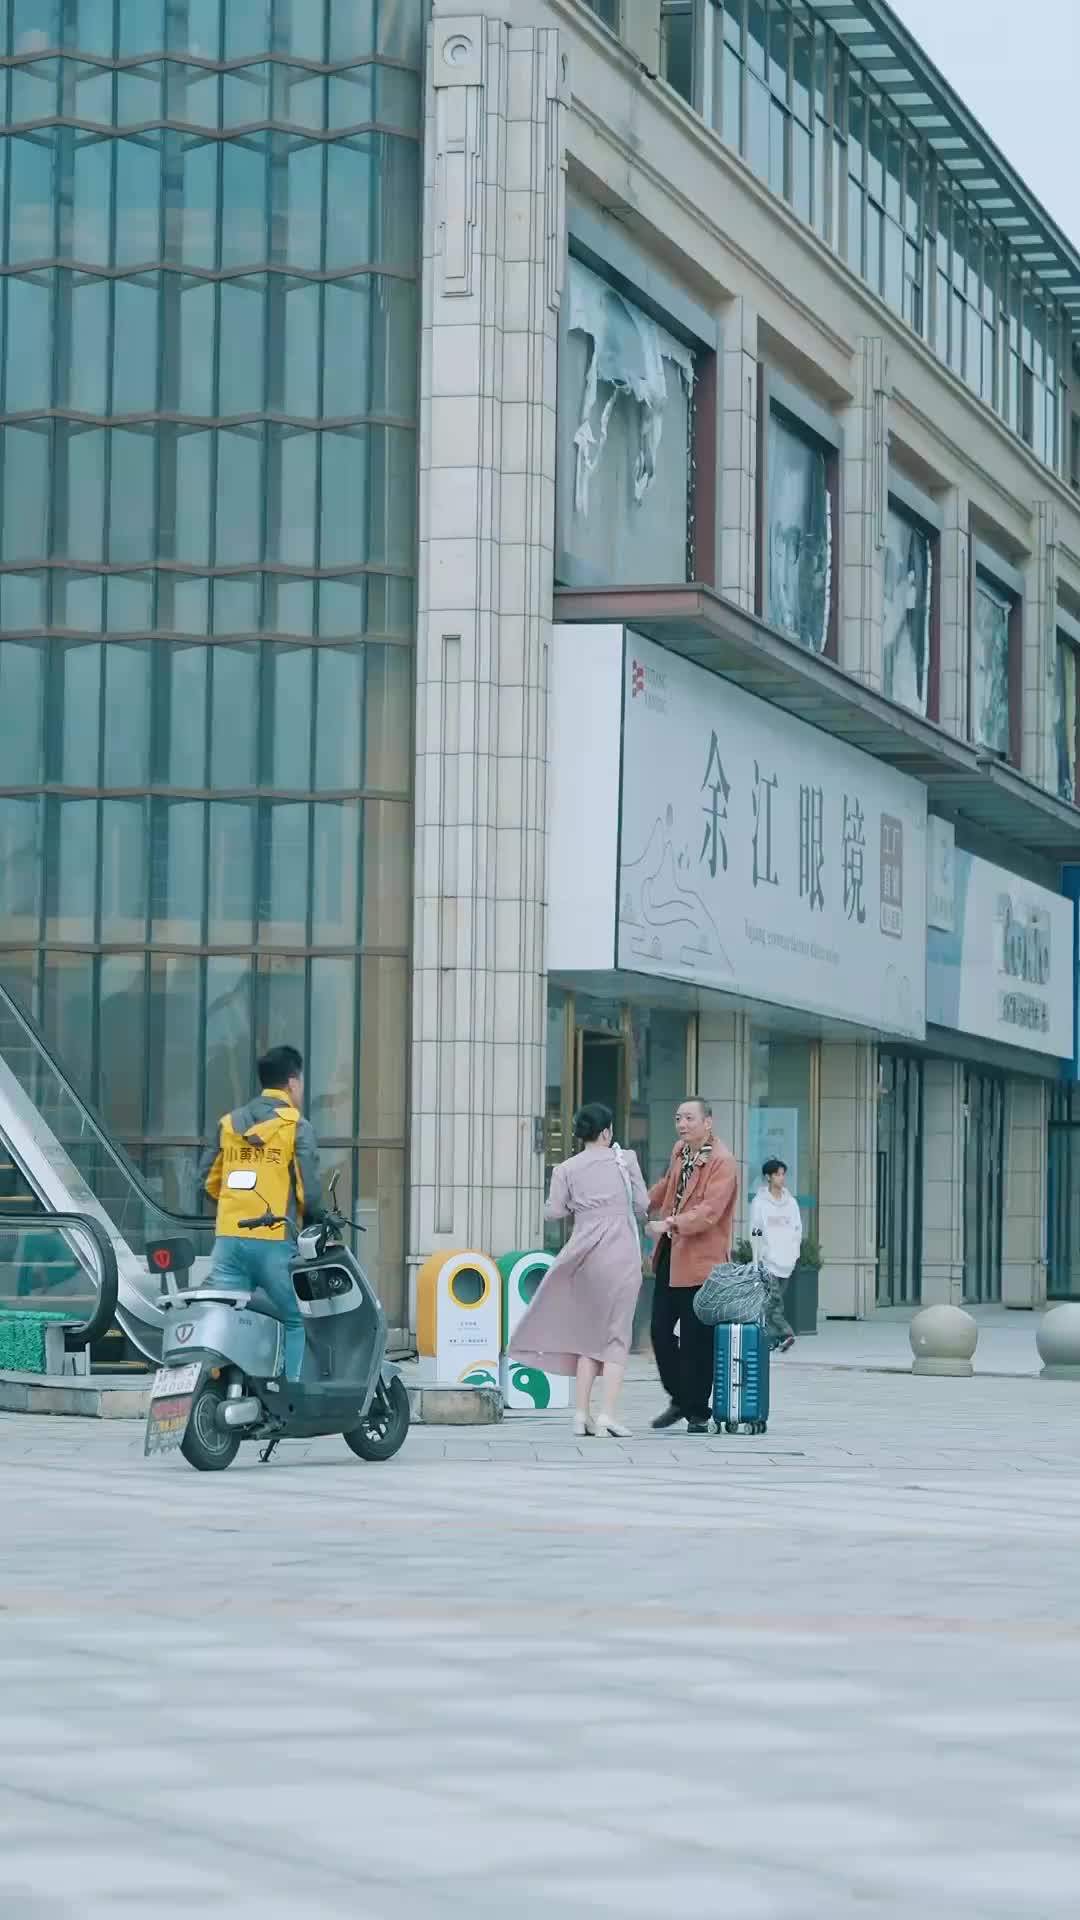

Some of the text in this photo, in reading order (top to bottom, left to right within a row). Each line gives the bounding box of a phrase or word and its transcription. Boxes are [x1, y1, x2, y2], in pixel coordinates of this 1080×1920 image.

[700, 729, 866, 924] 余江眼镜
[225, 1147, 281, 1164] 小黄外卖
